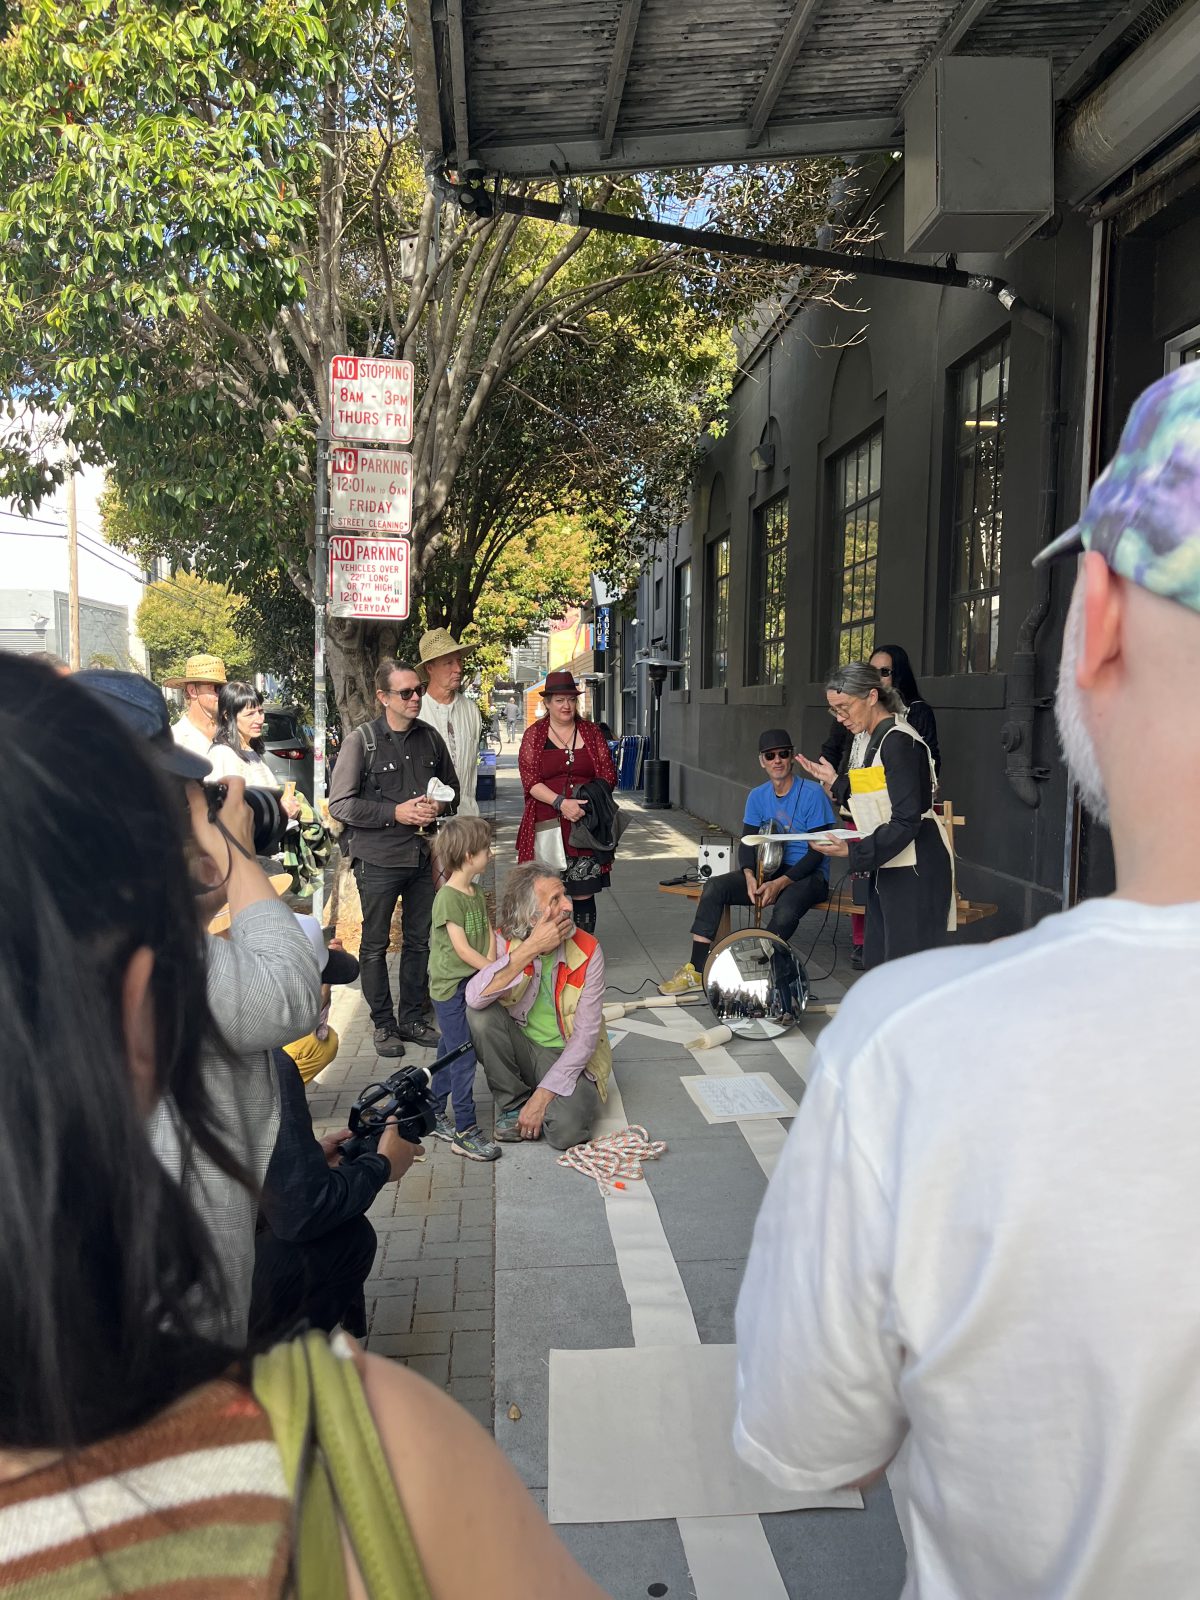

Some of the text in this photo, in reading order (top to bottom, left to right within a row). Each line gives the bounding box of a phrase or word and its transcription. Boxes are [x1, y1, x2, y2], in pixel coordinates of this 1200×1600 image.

[337, 360, 409, 380] NO STOPPING
[340, 387, 364, 403] 8AM
[384, 390, 408, 406] 3PM
[338, 410, 407, 427] THURS FRI
[335, 450, 408, 475] NO PARKING
[388, 480, 407, 496] 6AM
[349, 499, 392, 514] FRIDAY
[338, 517, 404, 530] STREET CLEANING
[332, 539, 404, 562] NO PARKING
[340, 563, 399, 573] VEHICLES OVER
[369, 574, 389, 582] LONG
[346, 582, 357, 590] OR
[374, 583, 393, 591] HIGH
[384, 593, 399, 604] 6AM
[353, 603, 391, 612] VERYDAY
